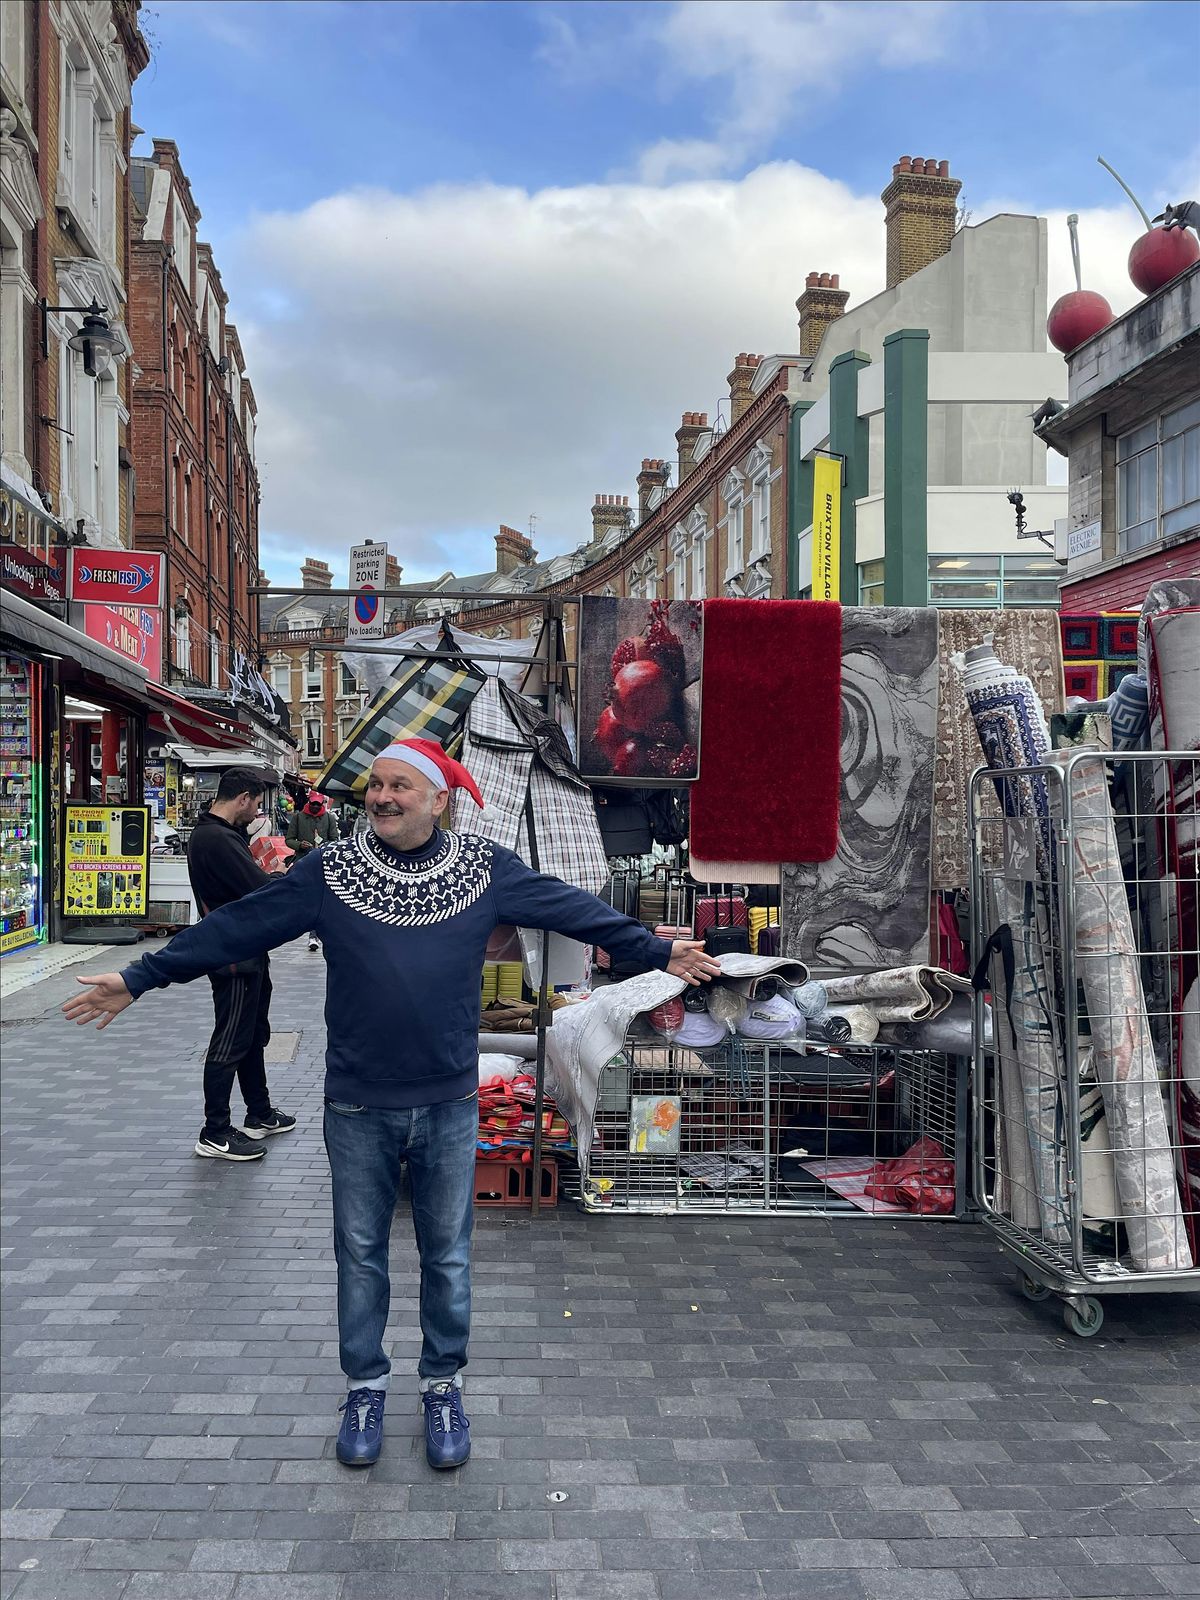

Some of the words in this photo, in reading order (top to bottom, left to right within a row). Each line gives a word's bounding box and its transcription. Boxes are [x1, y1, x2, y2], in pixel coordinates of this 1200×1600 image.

[1070, 528, 1097, 545] ELECTRIC
[352, 548, 385, 559] Restricted
[1070, 539, 1092, 555] AVENUE
[356, 560, 380, 569] parking
[4, 554, 34, 590] Unlocking
[43, 578, 60, 601] Vapes
[93, 568, 118, 584] FRESH
[119, 571, 138, 585] FISH
[355, 570, 379, 582] ZONE
[349, 627, 358, 636] No
[360, 626, 382, 636] loading
